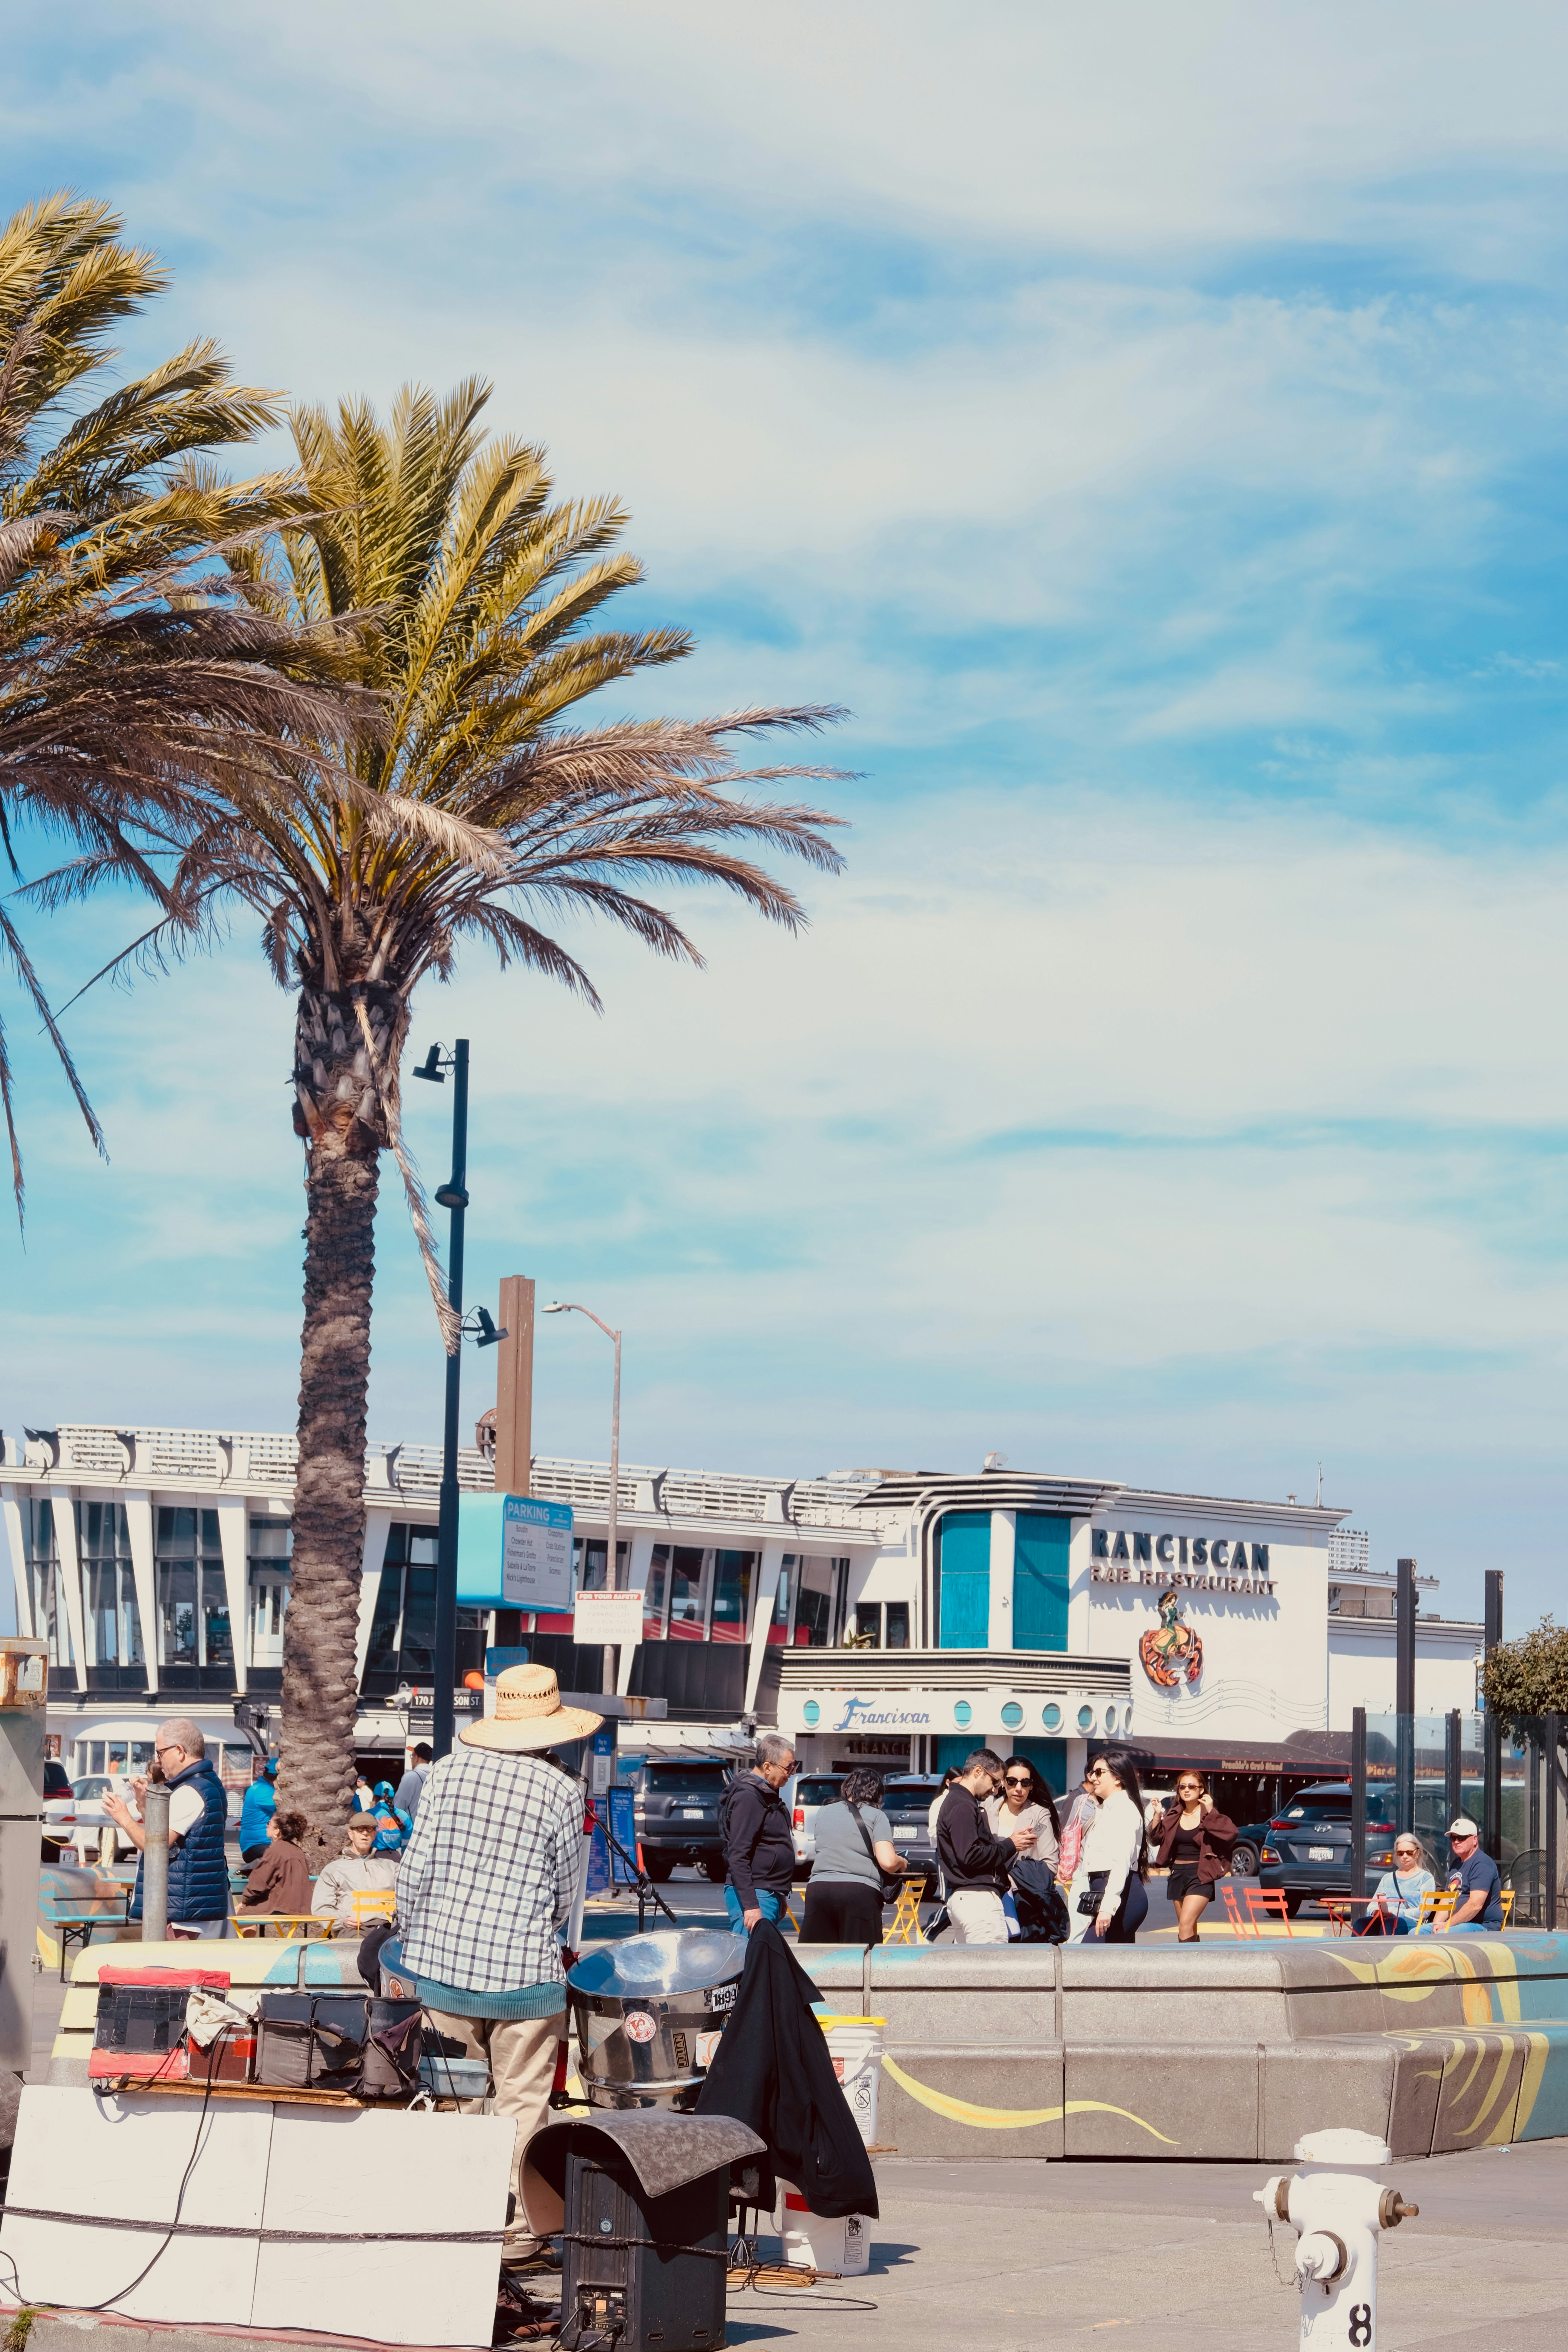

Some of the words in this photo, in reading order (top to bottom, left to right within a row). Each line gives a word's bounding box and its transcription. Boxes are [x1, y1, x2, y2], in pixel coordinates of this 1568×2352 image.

[507, 1502, 550, 1522] PARKING
[516, 1525, 528, 1533] Boudin
[511, 1537, 526, 1545] Chowder
[507, 1548, 525, 1558] Fisherman's
[526, 1551, 537, 1559] Grotto
[1092, 1528, 1269, 1571] RANCISCAN
[547, 1554, 564, 1563] Franciscan
[549, 1567, 561, 1575] Scomas
[506, 1573, 516, 1581] Nick's
[517, 1574, 536, 1584] Lighthouse
[1090, 1566, 1132, 1583] RAB
[1140, 1570, 1279, 1595] RESTAURANT
[415, 1696, 429, 1706] 170
[471, 1697, 479, 1706] ST
[833, 1696, 931, 1731] Franciscan
[1367, 1765, 1386, 1775] Pier
[713, 1989, 736, 2006] 1899
[675, 2035, 687, 2066] JULIAN
[1349, 2303, 1372, 2347] 8
